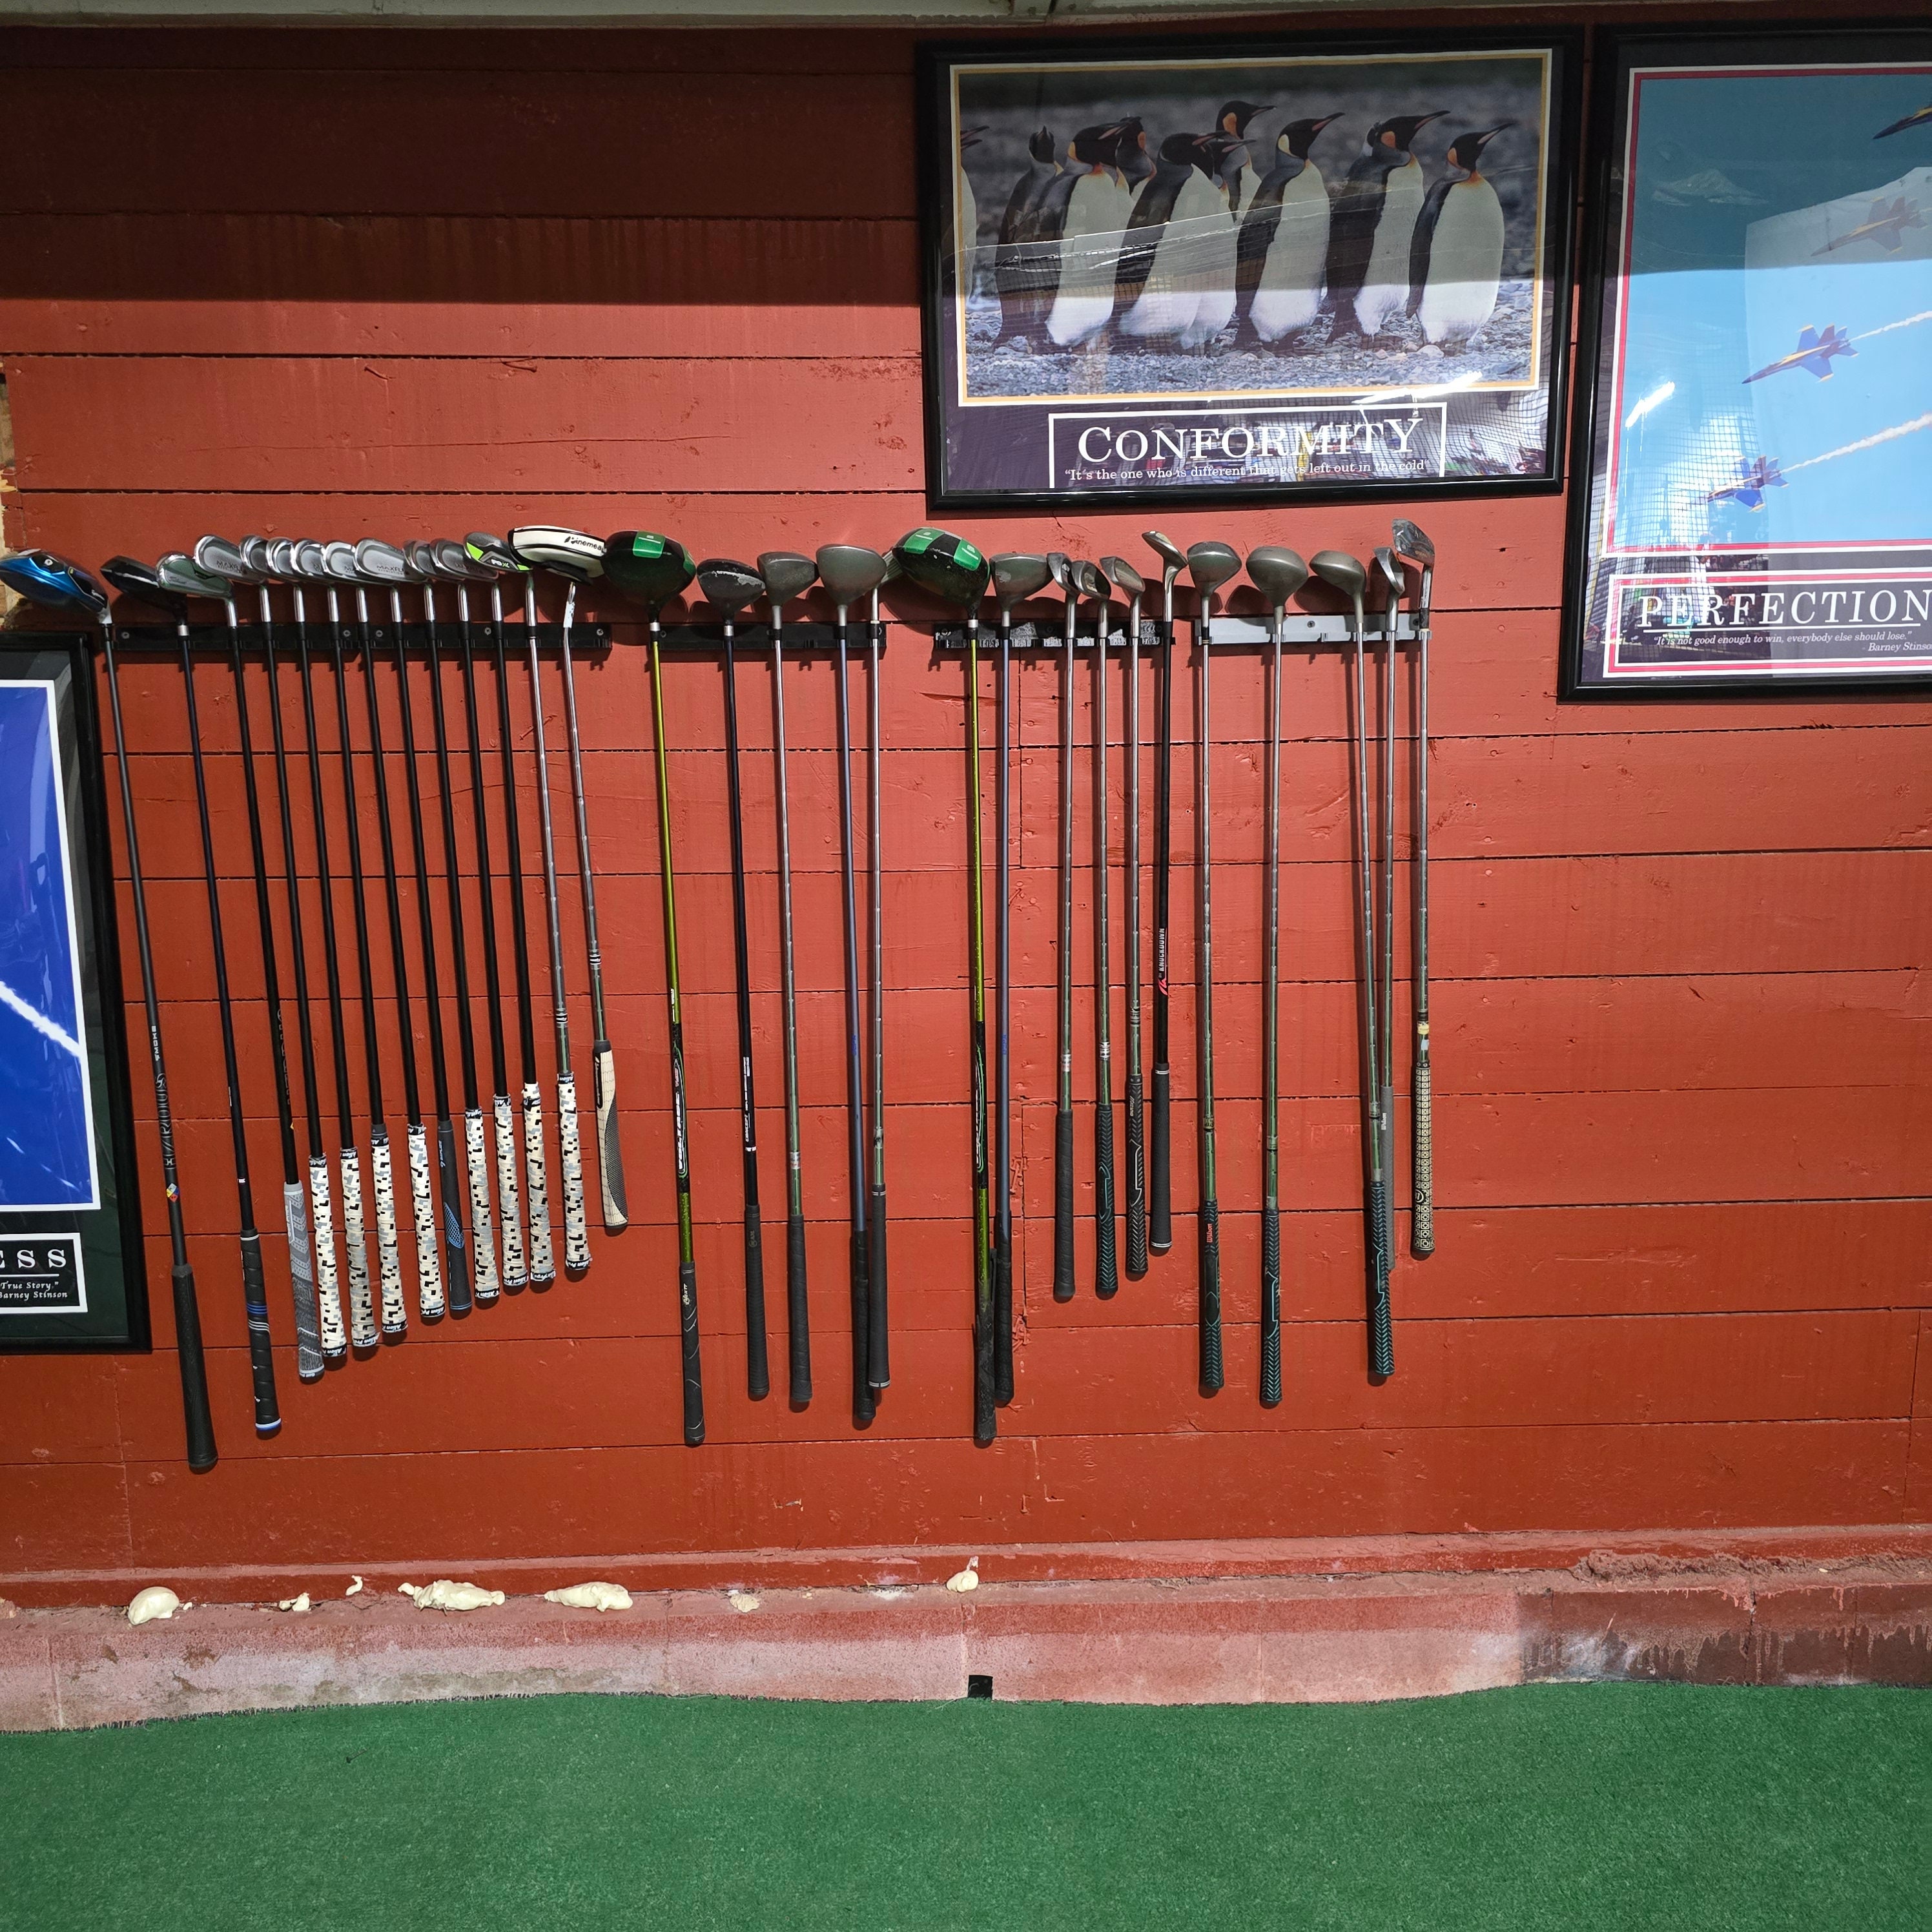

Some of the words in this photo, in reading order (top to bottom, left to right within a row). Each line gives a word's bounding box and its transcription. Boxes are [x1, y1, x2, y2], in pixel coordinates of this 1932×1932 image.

[1078, 418, 1423, 462] CONFORMITY
[1096, 469, 1117, 480] the
[1120, 470, 1143, 479] one
[1147, 467, 1173, 478] who
[1176, 466, 1187, 477] is
[1191, 465, 1245, 477] different
[1249, 464, 1275, 475] that
[1280, 464, 1306, 476] gets
[1309, 462, 1331, 473] left
[1333, 462, 1356, 473] out
[1358, 461, 1371, 472] in
[1375, 460, 1396, 472] the
[1637, 590, 1932, 627] PERFECTION
[1667, 637, 1675, 645] is
[1694, 635, 1715, 646] good
[1718, 634, 1751, 644] enough
[1753, 635, 1763, 643] to
[1765, 635, 1784, 644] win,
[1787, 632, 1833, 644] everybody
[1834, 632, 1852, 641] else
[1854, 631, 1885, 641] should
[1867, 642, 1901, 653] Barney
[151, 1025, 160, 1062] SMOKE
[0, 1280, 23, 1290] True
